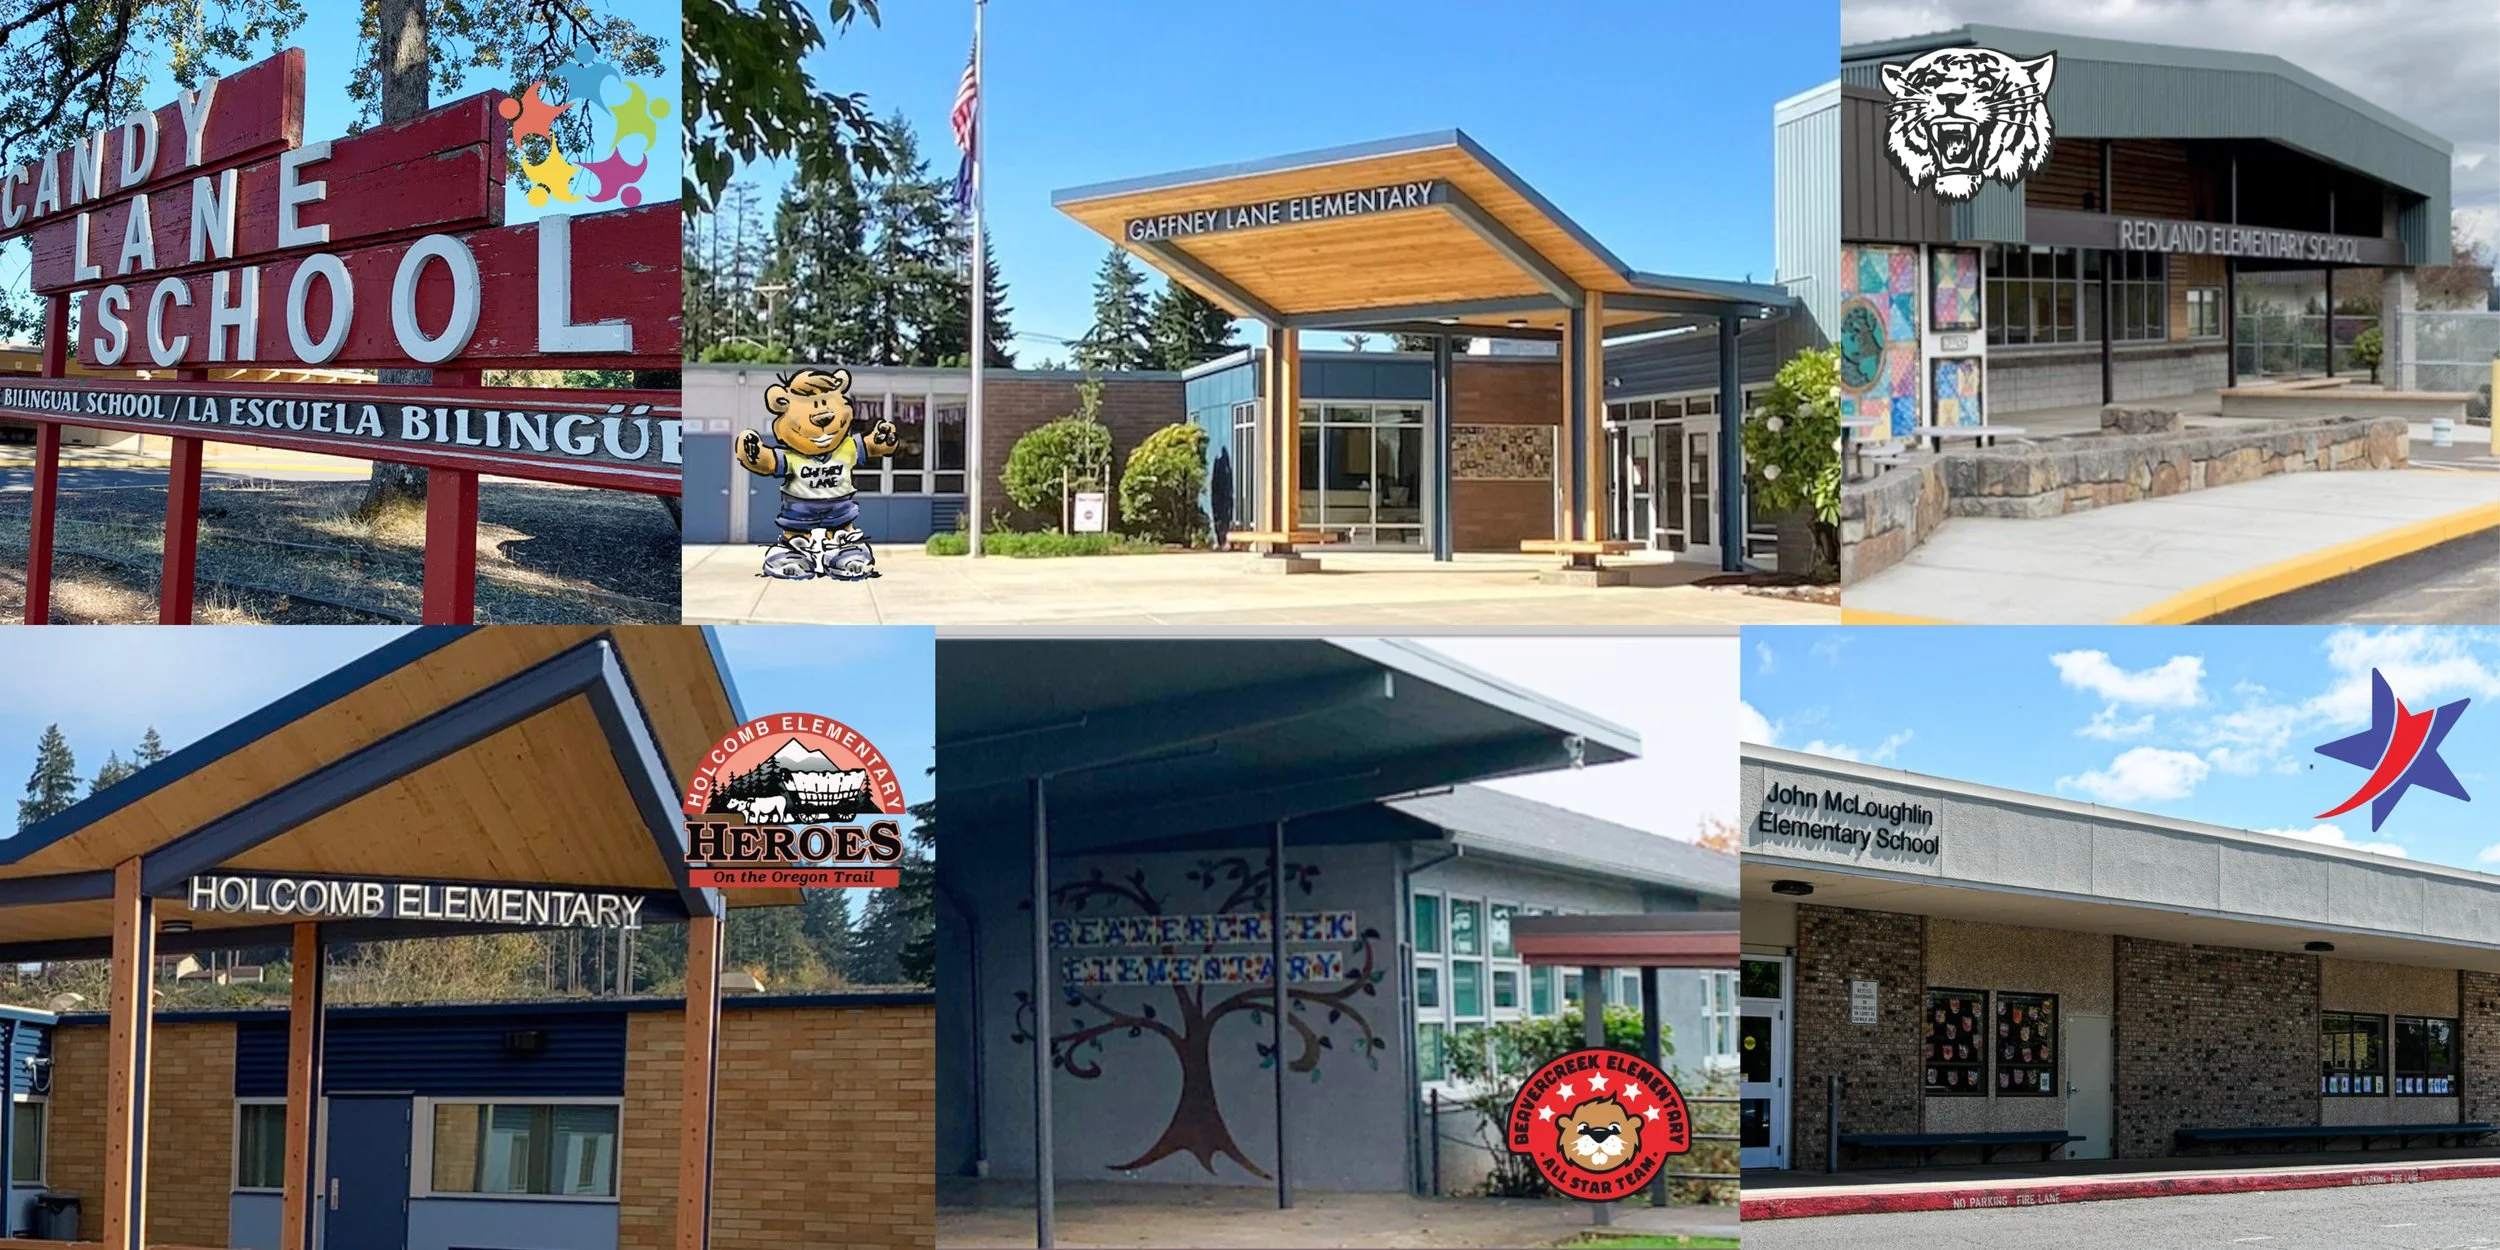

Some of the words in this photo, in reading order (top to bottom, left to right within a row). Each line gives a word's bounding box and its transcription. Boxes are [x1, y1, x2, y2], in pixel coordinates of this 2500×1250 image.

[2, 78, 220, 228] CANDY
[74, 141, 332, 283] LANE
[1128, 210, 1218, 242] GAFFNEY
[1226, 202, 1280, 229] LANE
[1290, 181, 1434, 222] ELEMENTARY
[2120, 220, 2208, 254] REDLAND
[2212, 227, 2306, 260] ELEMENTARY
[2306, 235, 2362, 263] SCHOOL
[94, 213, 633, 367] SCHOOL
[4, 388, 81, 413] BILINGUAL
[86, 392, 165, 419] SCHOOL
[188, 397, 219, 423] LA
[229, 398, 384, 437] ESCUELA
[1767, 782, 1818, 808] John
[1825, 789, 1933, 826] McLoughlin
[1759, 810, 1872, 850] Elementary
[1876, 828, 1940, 855] School
[189, 875, 385, 916] HOLCOMB
[396, 883, 646, 929] ELEMENTARY
[1050, 912, 1355, 947] BEAVERCREK
[1953, 1198, 1966, 1209] NO
[1969, 1195, 2008, 1209] PARKING
[2016, 1194, 2035, 1206] FIRE
[2039, 1192, 2060, 1205] LANE
